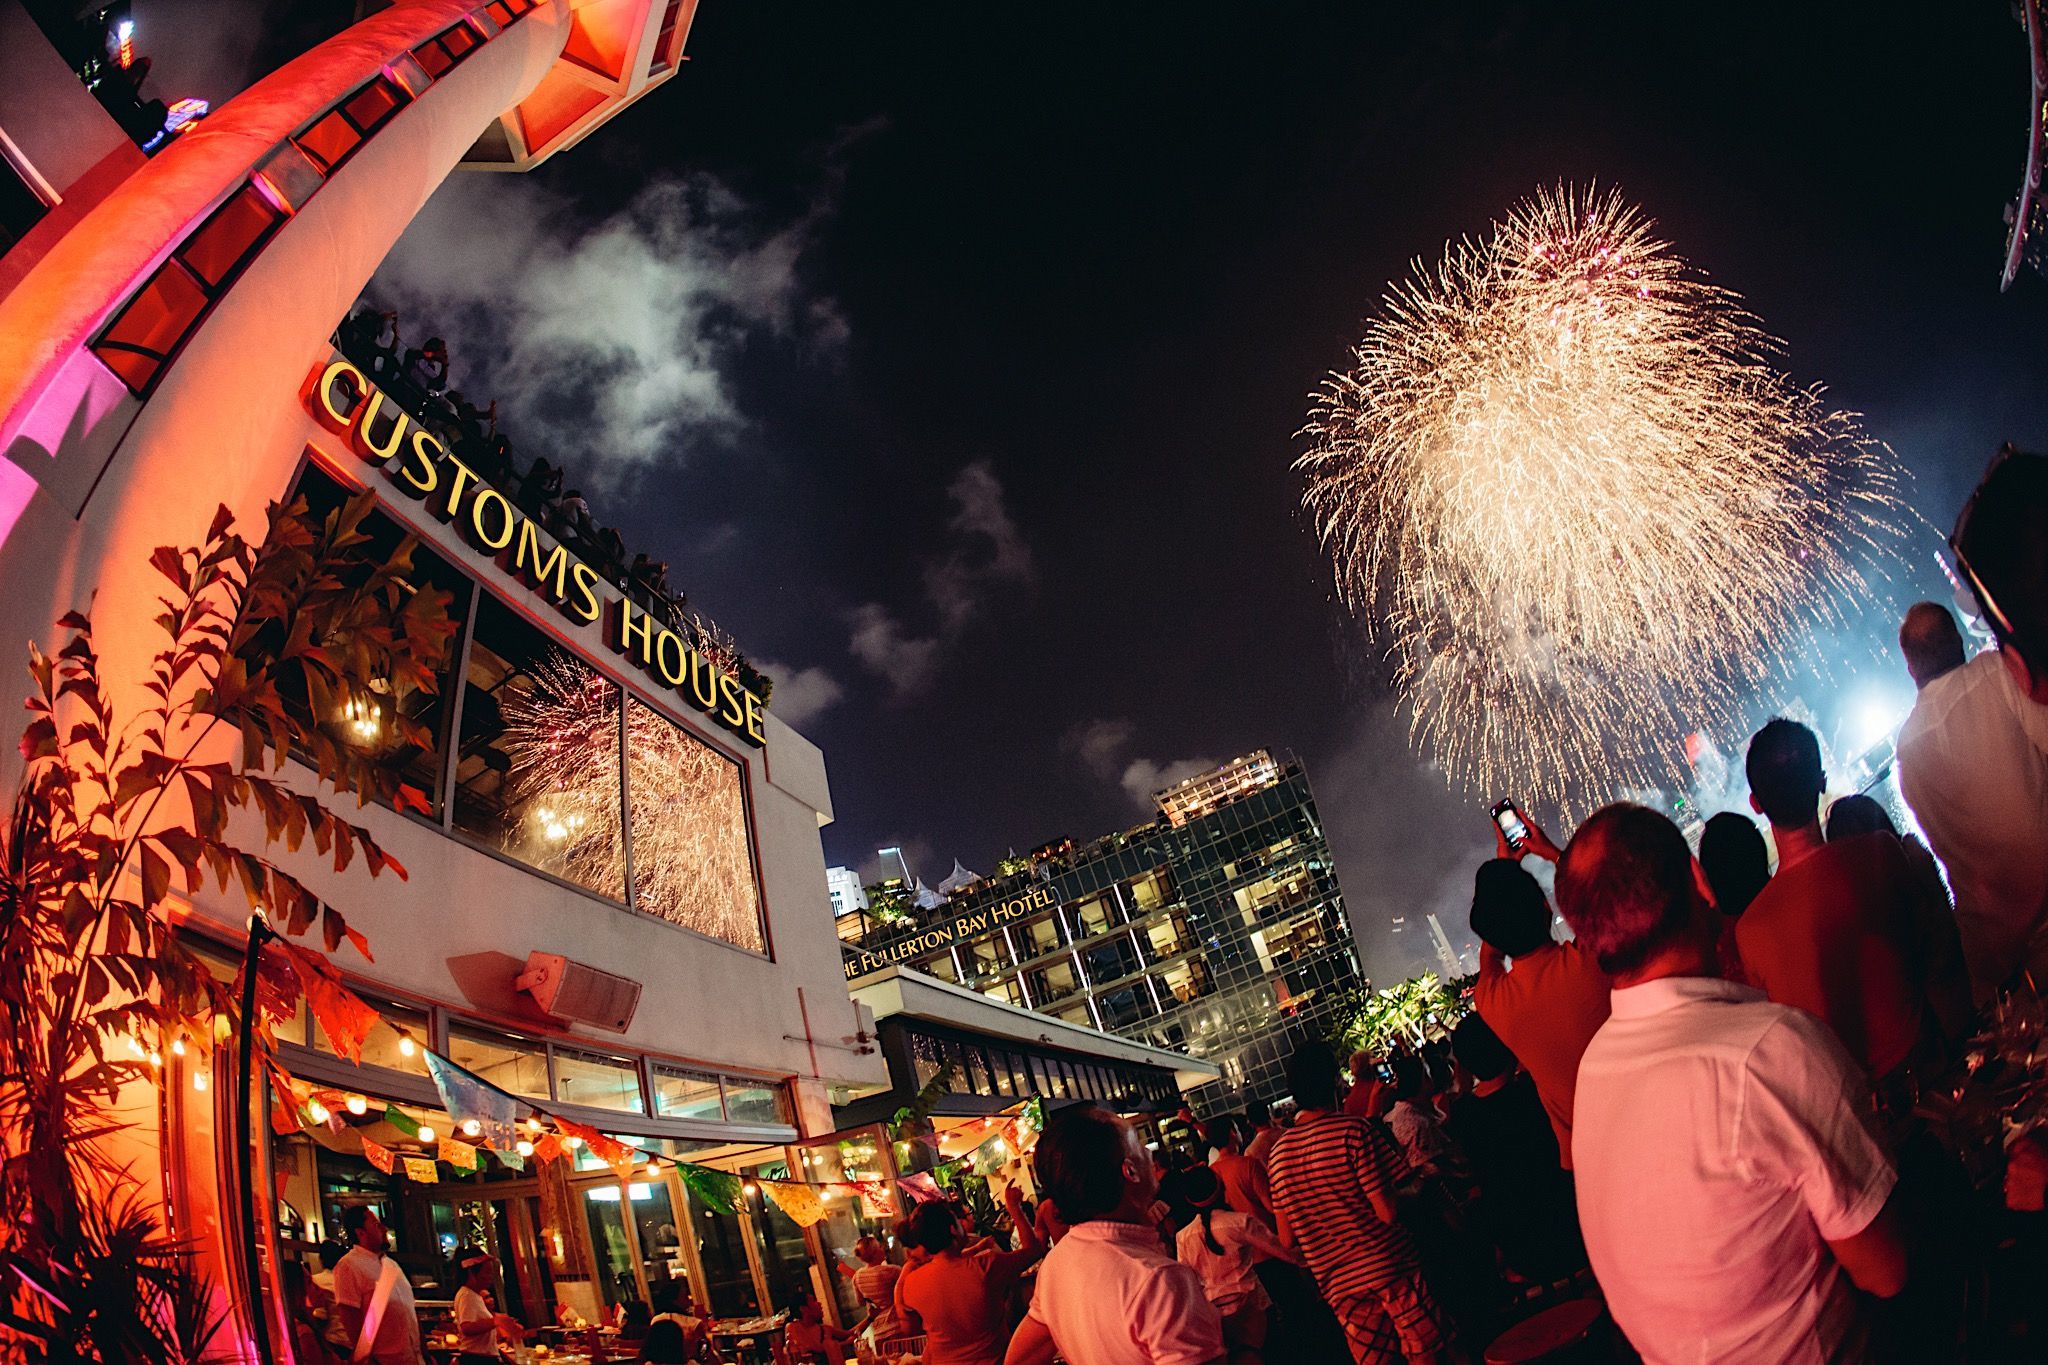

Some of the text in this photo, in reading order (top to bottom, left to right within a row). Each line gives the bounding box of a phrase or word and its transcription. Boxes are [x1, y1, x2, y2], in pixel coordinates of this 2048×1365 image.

[320, 361, 767, 744] CUSTOMS HOUSE
[844, 889, 1055, 977] HE FULLERTON BAY HOTEL
